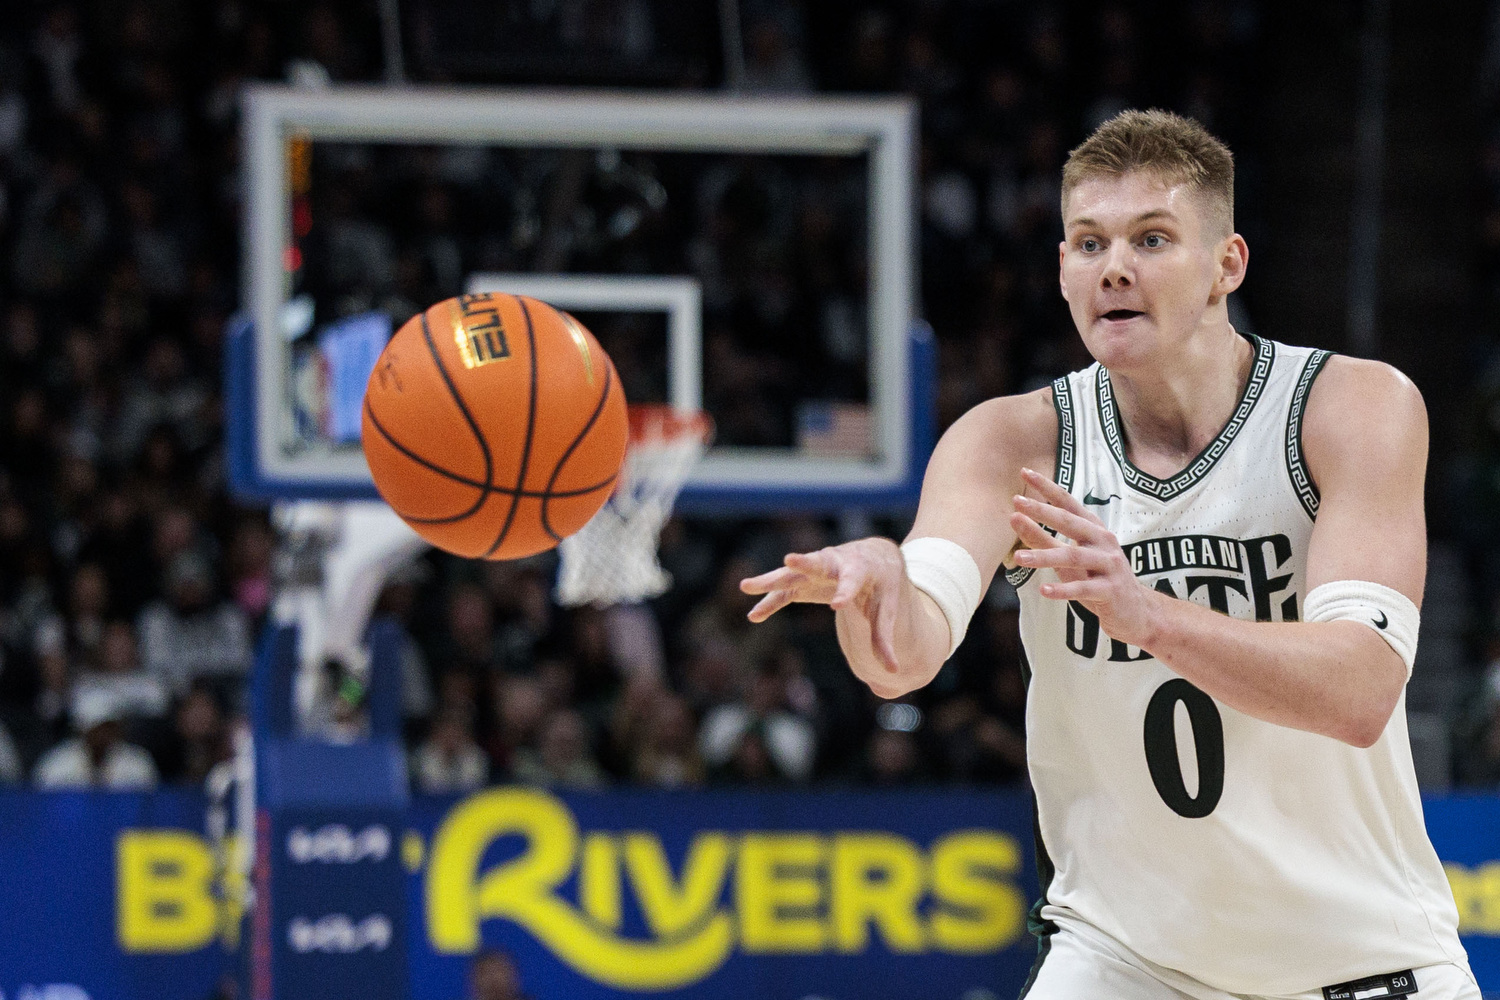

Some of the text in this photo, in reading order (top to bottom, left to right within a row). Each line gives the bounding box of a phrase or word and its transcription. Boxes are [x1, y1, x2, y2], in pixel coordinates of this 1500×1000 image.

[1130, 537, 1239, 575] CHIGAN
[1143, 678, 1226, 820] 0
[1392, 976, 1408, 988] 50
